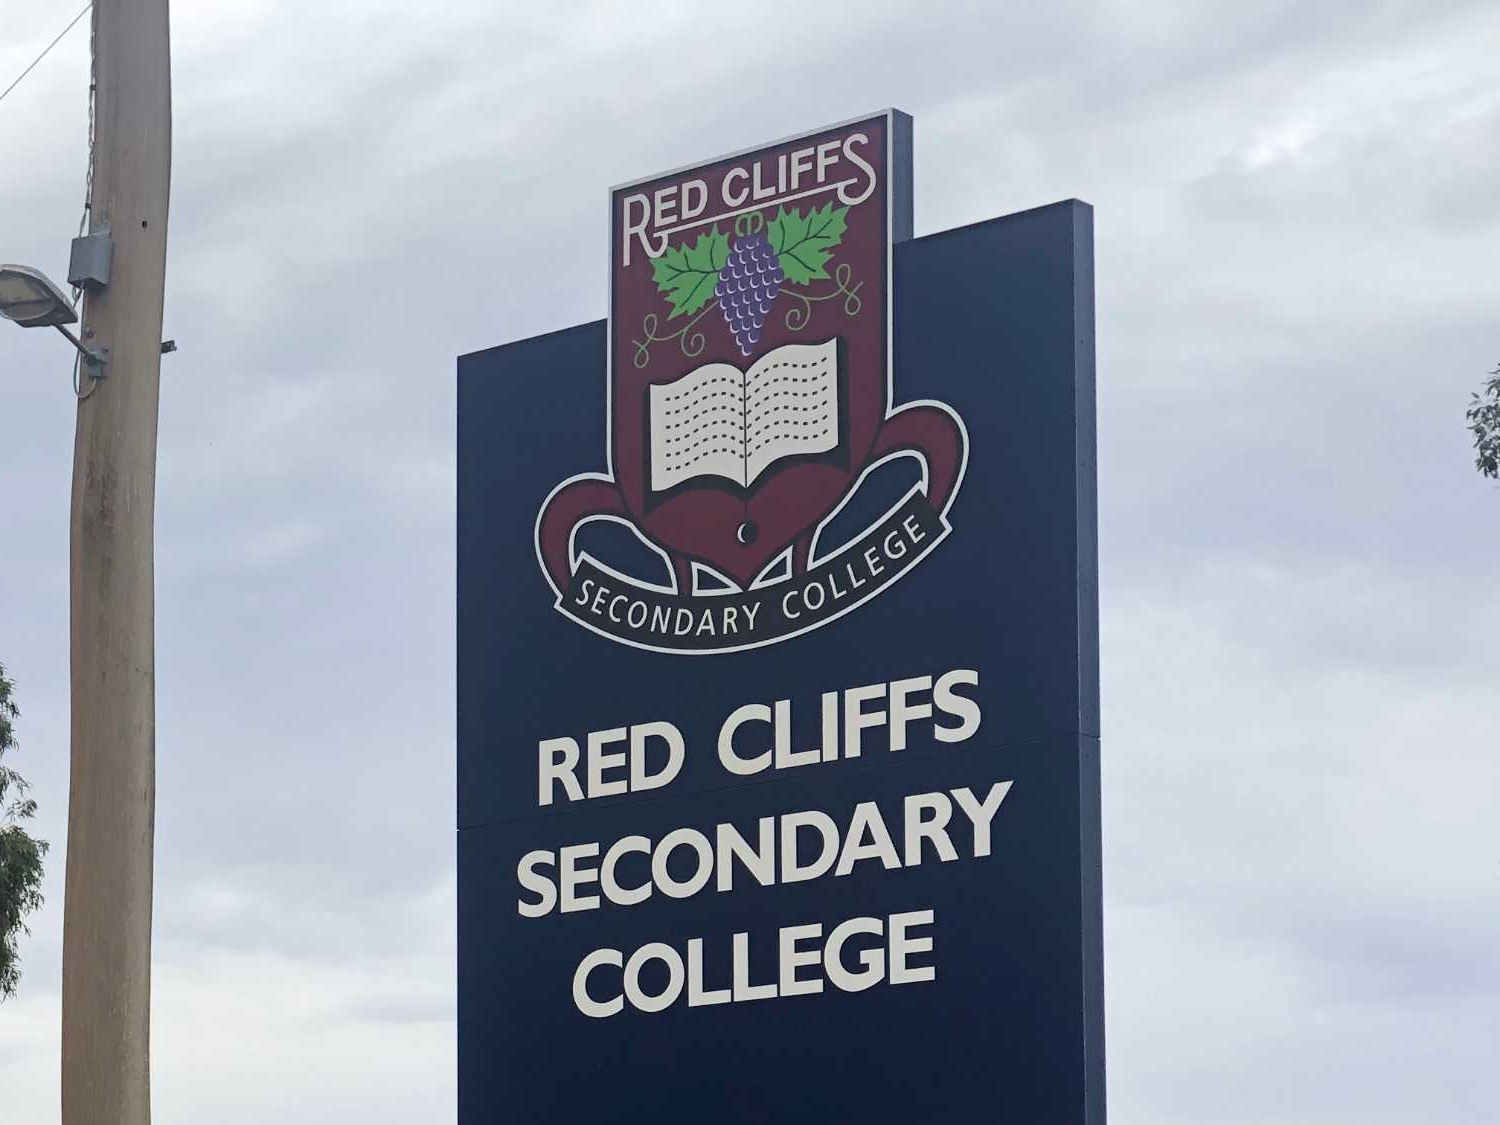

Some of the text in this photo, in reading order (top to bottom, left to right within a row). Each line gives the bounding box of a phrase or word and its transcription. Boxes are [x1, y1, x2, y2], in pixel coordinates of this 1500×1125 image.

[622, 133, 877, 267] RED CLIFFS
[575, 514, 926, 636] SECONDARY COLLEGE
[538, 669, 981, 807] RED CLIFFS
[516, 780, 1014, 918] SECONDARY
[572, 909, 936, 1018] COLLEGE
